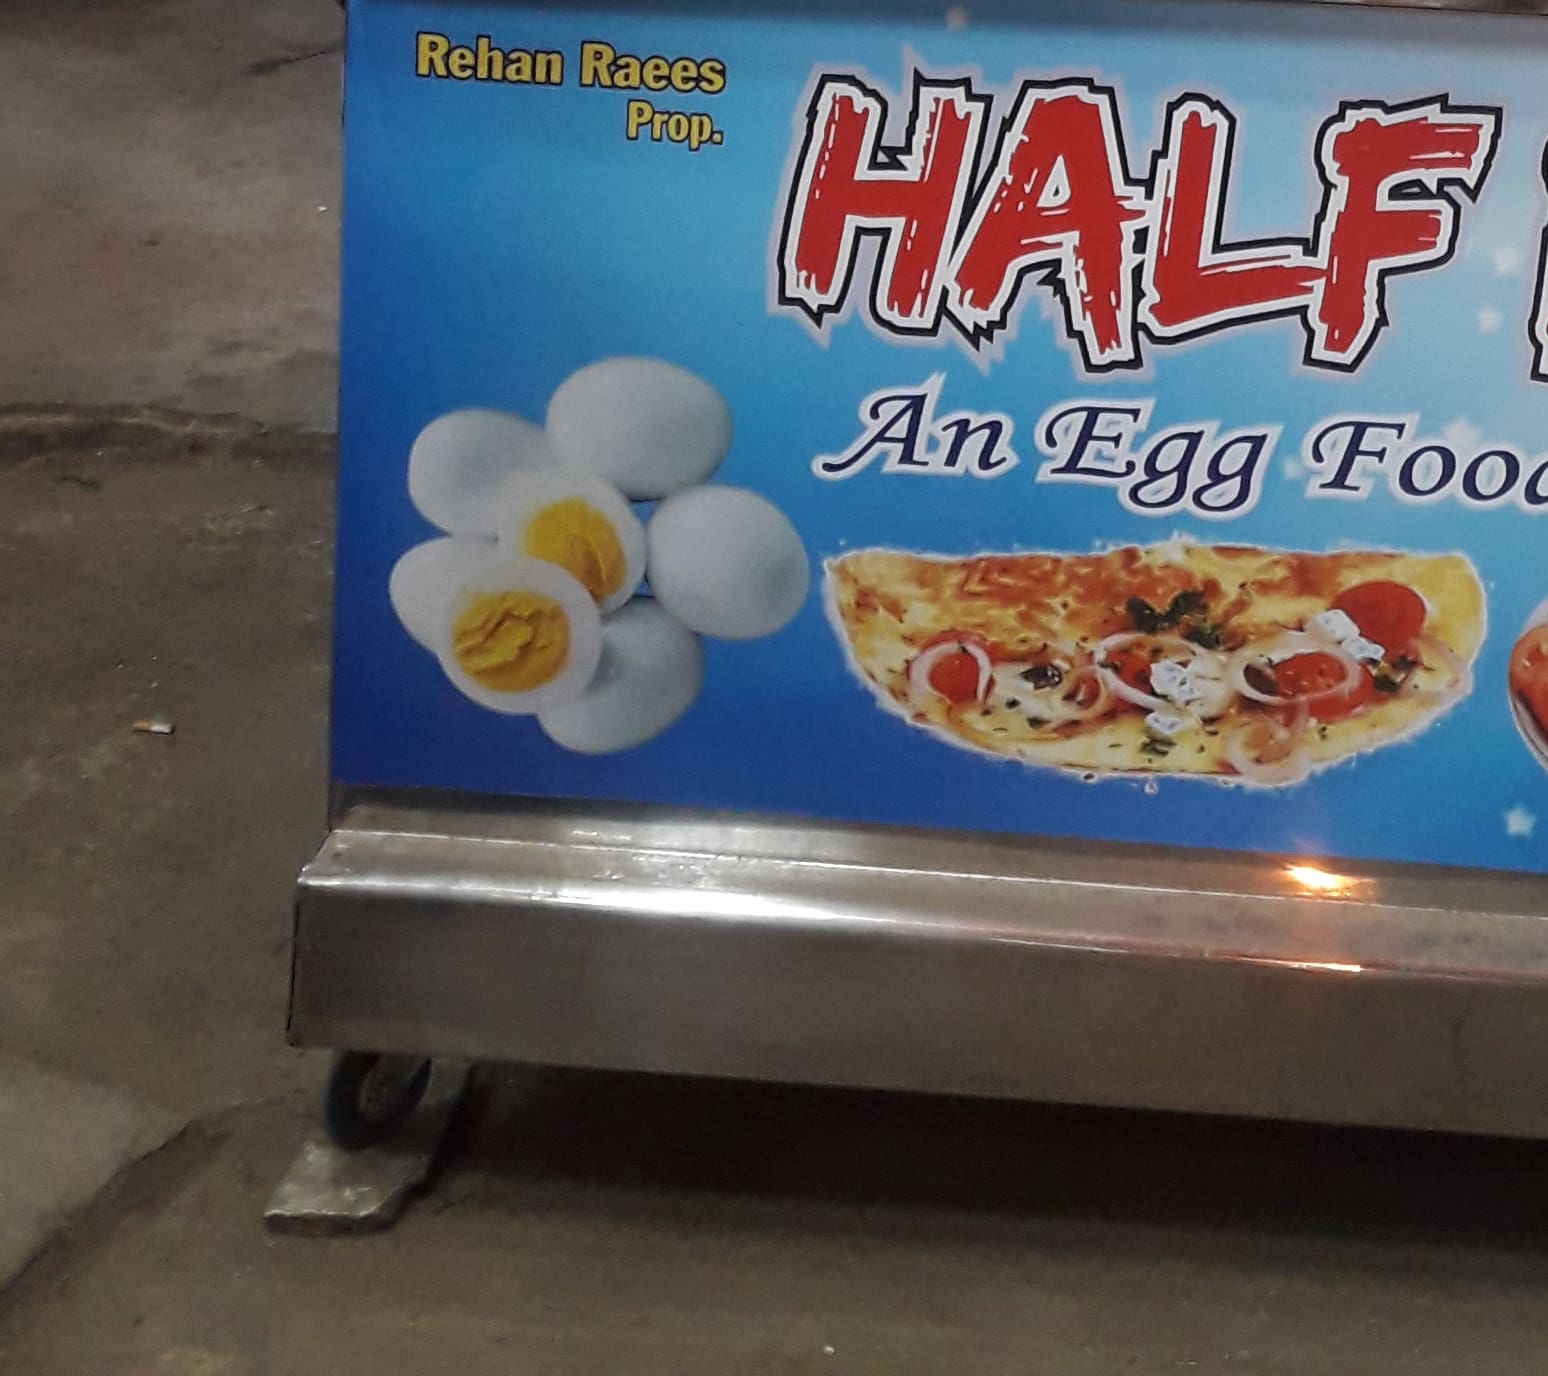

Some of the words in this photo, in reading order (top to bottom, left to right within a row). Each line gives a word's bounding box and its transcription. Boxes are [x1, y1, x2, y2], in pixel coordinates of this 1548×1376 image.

[415, 31, 565, 86] Rehan
[579, 41, 727, 94] Raees
[626, 98, 724, 152] Prop.
[780, 68, 1502, 374] HALF
[820, 391, 1008, 472] An
[1044, 405, 1270, 513] Egg
